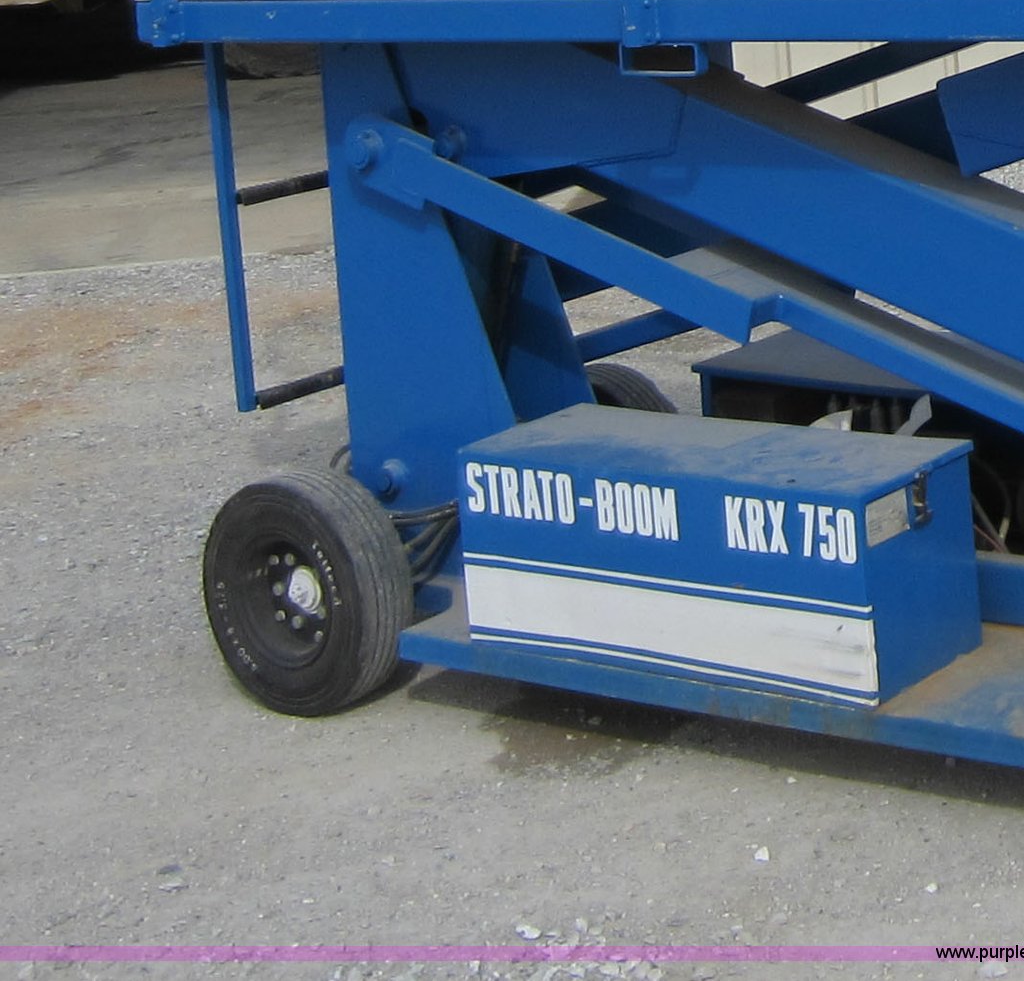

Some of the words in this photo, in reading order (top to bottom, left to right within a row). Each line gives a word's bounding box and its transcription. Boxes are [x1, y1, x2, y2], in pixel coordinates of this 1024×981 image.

[464, 460, 680, 542] STRATO-BOOM
[723, 494, 790, 555] KRX
[797, 501, 858, 566] 750
